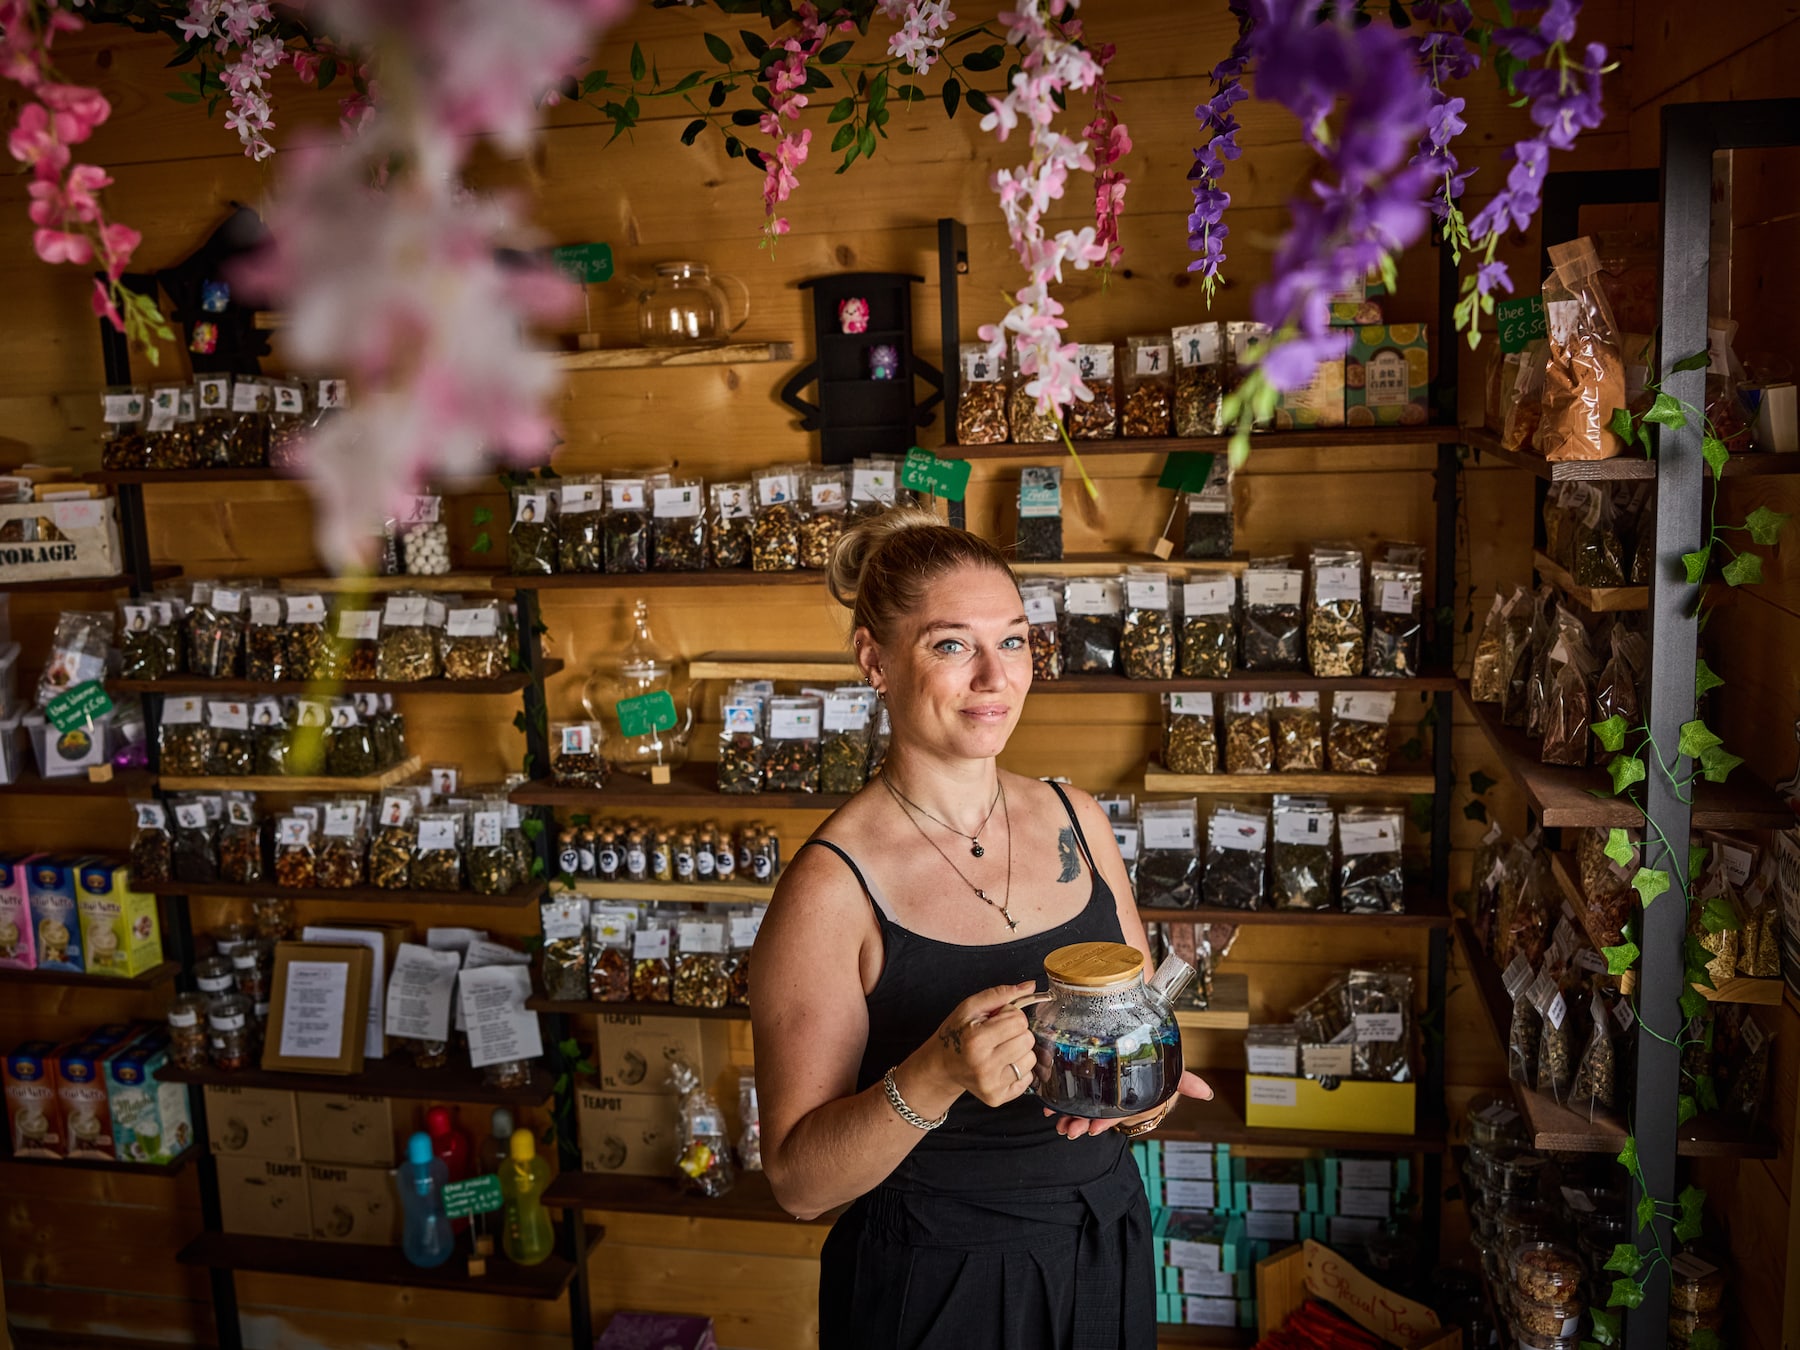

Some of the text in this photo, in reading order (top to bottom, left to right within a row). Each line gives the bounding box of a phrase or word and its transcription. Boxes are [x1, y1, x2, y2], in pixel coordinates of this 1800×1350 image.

[1498, 307, 1525, 321] thee
[582, 1094, 622, 1111] TEAPOT
[1321, 1260, 1419, 1340] Special Tea
